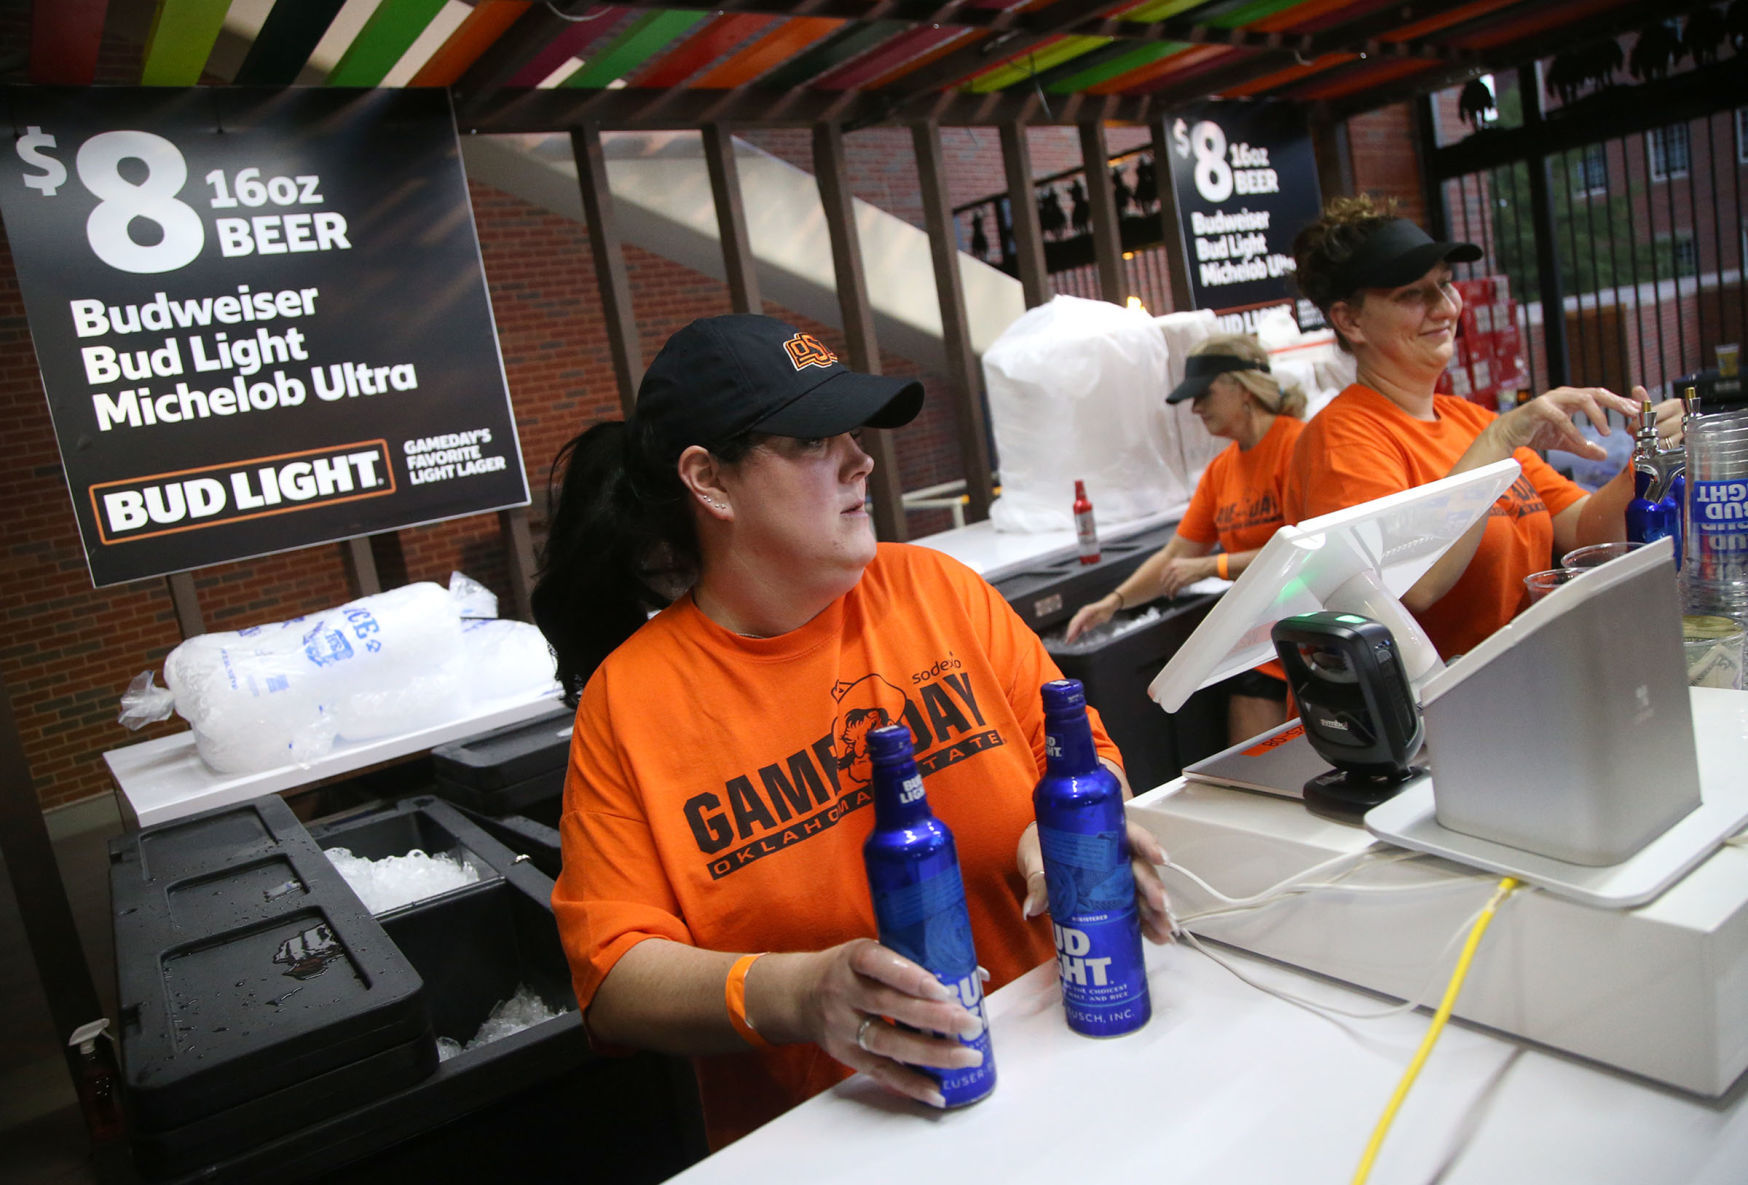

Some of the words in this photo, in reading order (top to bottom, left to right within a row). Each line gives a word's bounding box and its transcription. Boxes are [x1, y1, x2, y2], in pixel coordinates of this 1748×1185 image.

[1229, 142, 1270, 168] 16oz
[206, 168, 324, 209] 16oz
[1233, 168, 1279, 195] BEER
[16, 126, 205, 274] $8
[216, 212, 352, 257] BEER
[1191, 207, 1270, 236] Budweiser
[1195, 235, 1229, 262] Bud
[1228, 232, 1268, 260] Light
[1199, 257, 1267, 287] Michelob
[71, 285, 319, 337] Budweiser
[82, 338, 184, 385] Bud
[190, 328, 309, 376] Light
[92, 372, 306, 432] Michelob
[312, 361, 418, 401] Ultra
[403, 428, 492, 455] GAMEDAY'S
[406, 445, 482, 470] FAVORITE
[409, 464, 455, 485] LIGHT
[456, 456, 506, 477] LAGER
[104, 479, 227, 533] BUD
[230, 451, 381, 510] LIGHT
[1696, 483, 1748, 502] GHT
[900, 786, 926, 804] LIG
[903, 774, 923, 793] BU
[712, 789, 873, 877] OKLAHOMA
[921, 732, 1001, 770] TATE
[1054, 922, 1091, 957] UD
